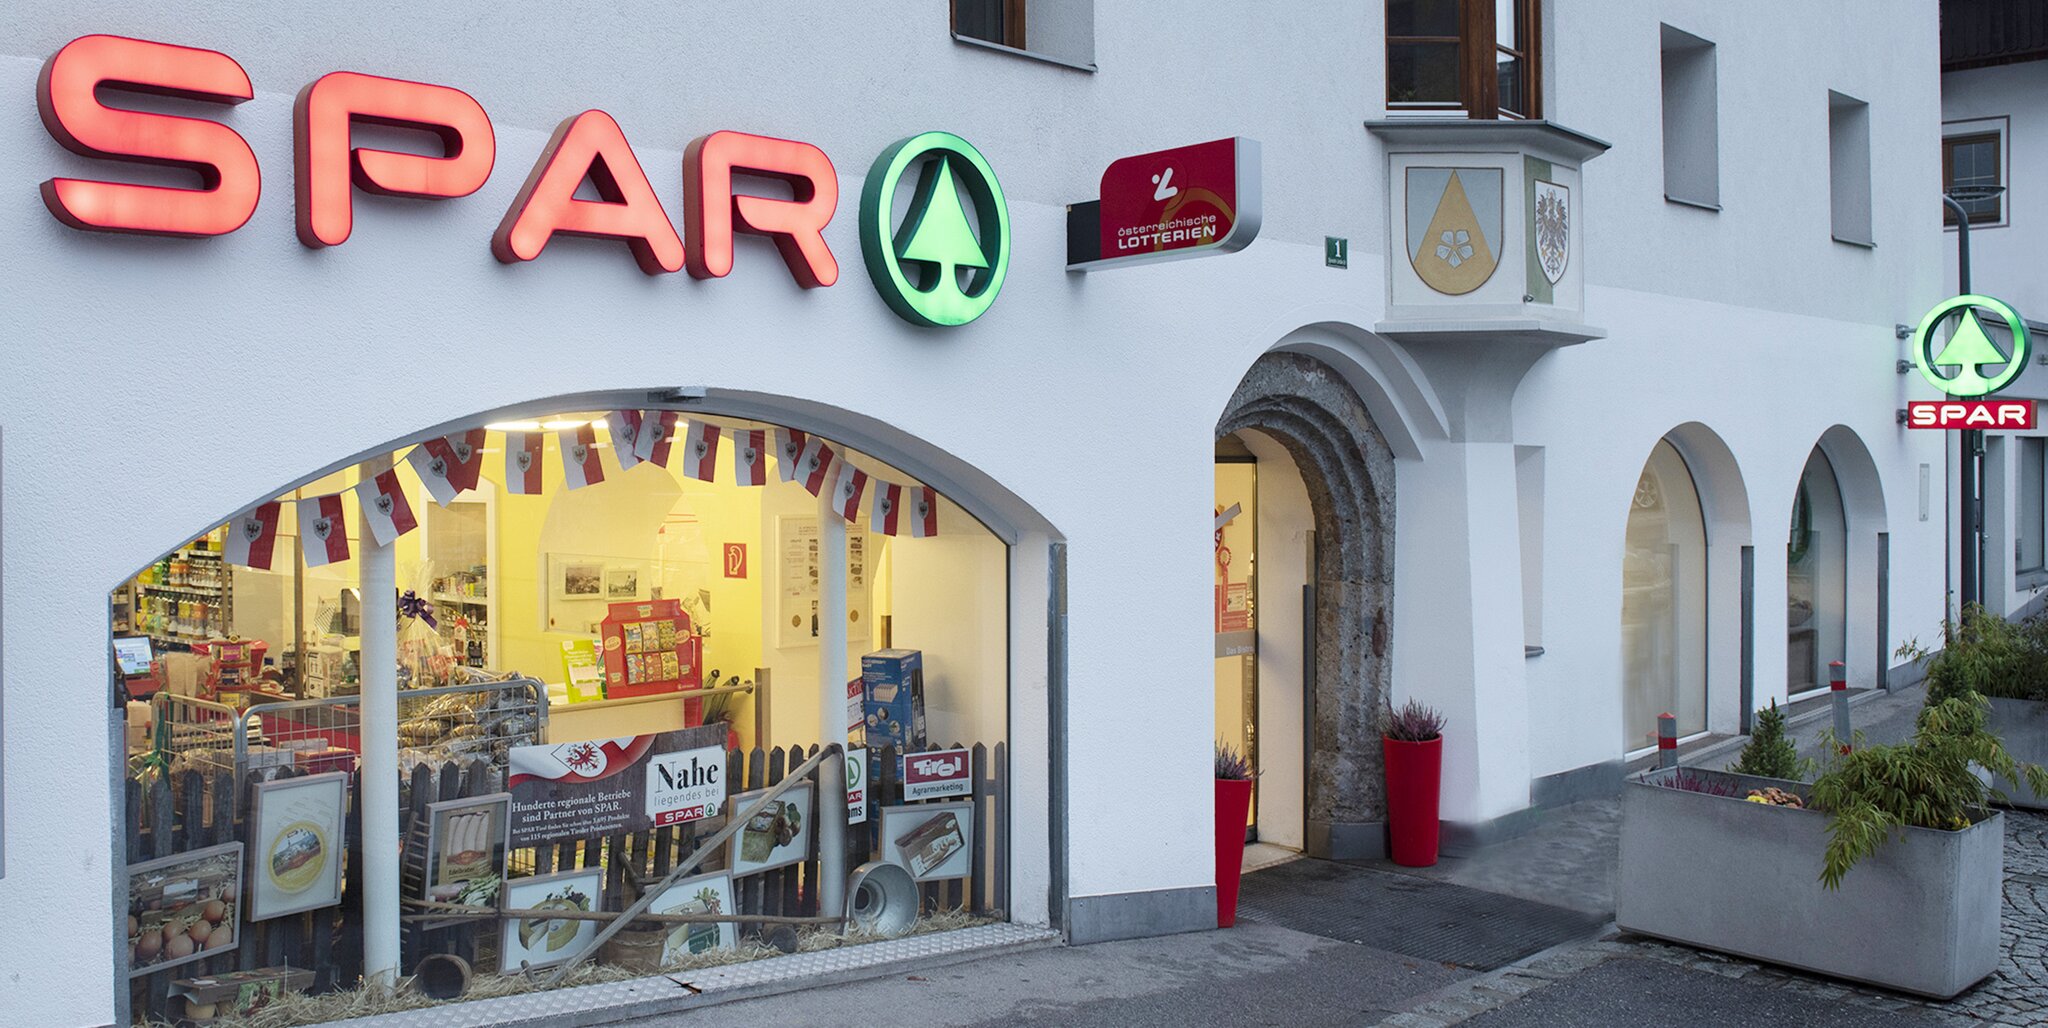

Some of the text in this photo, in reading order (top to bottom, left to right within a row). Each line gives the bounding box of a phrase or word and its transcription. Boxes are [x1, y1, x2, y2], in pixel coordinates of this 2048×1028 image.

[36, 33, 839, 288] SPAR
[1117, 214, 1217, 237] österreichische
[1118, 224, 1216, 249] LOTTERIEN
[1335, 239, 1341, 258] 1
[1912, 404, 2027, 426] SPAR
[654, 756, 719, 794] Nahe
[914, 756, 961, 777] Tirol
[512, 788, 632, 813] Hunderte regionale Betriebe
[654, 786, 719, 807] liegendes bei
[912, 783, 964, 796] Agrarmarketing
[522, 801, 622, 823] sind Partner von SPAR.
[664, 807, 703, 823] SPAR
